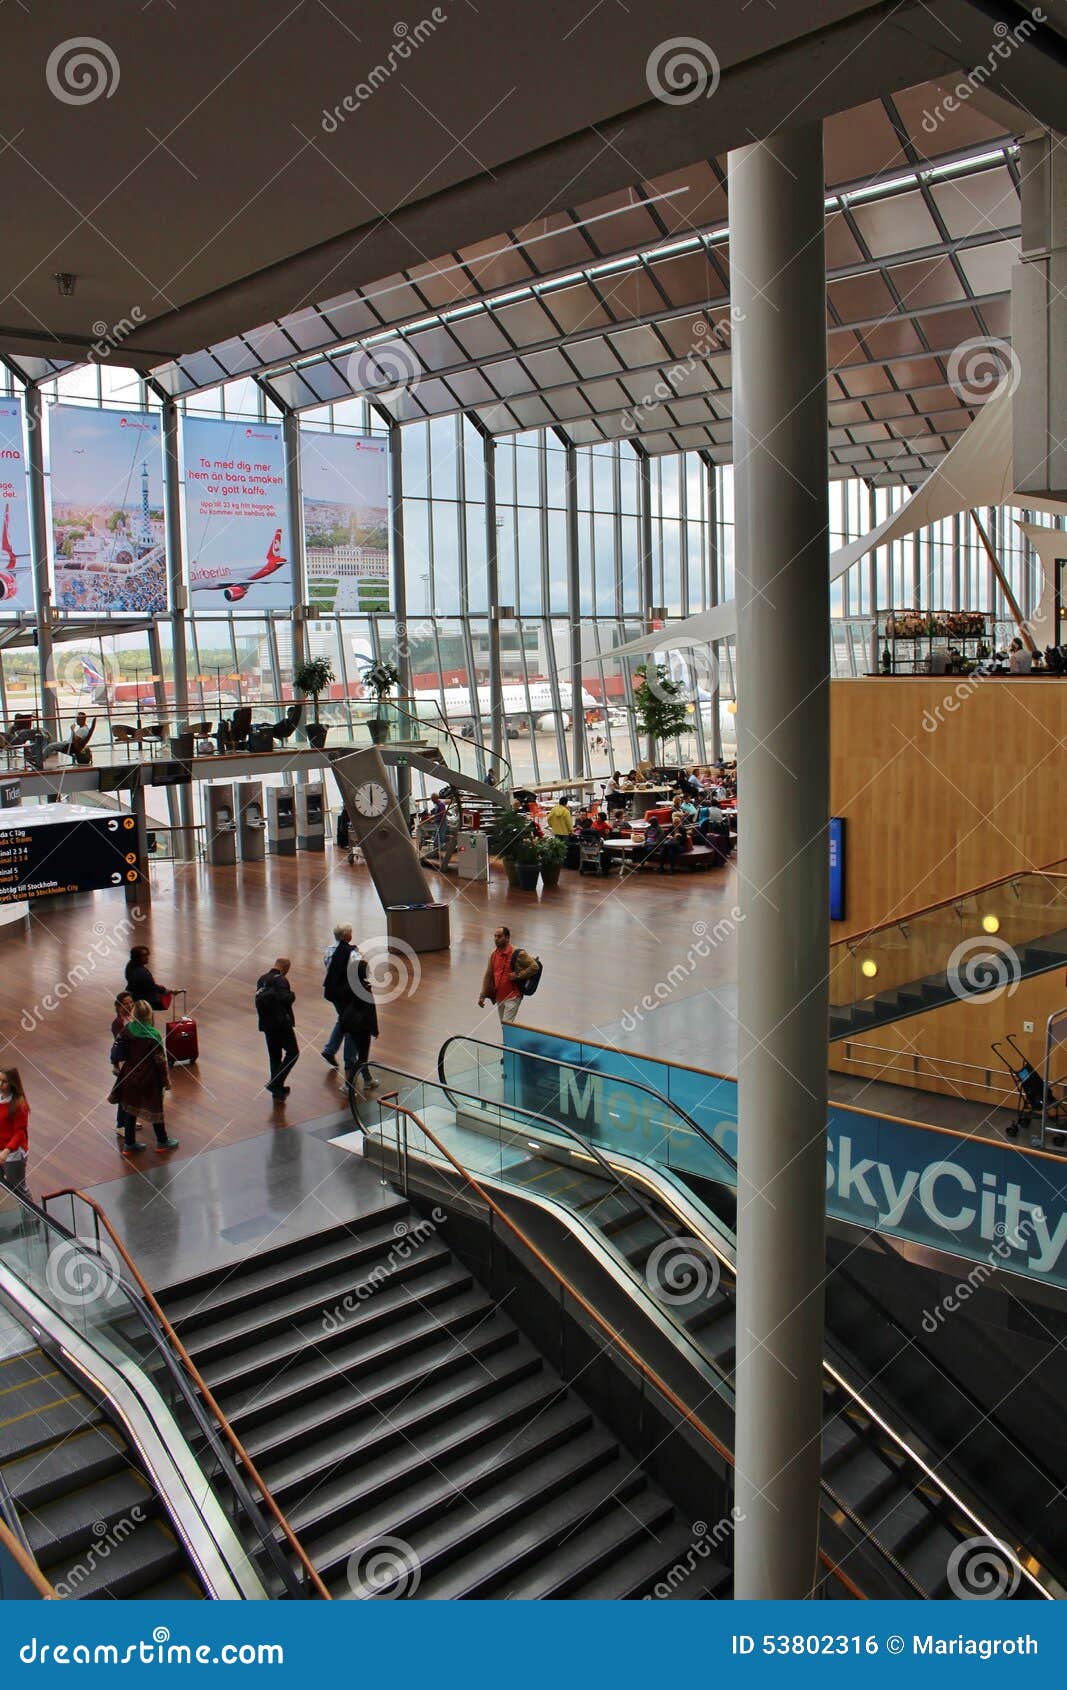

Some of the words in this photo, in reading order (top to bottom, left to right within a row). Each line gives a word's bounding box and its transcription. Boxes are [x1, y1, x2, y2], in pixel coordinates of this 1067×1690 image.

[200, 458, 211, 468] Ta
[214, 460, 234, 470] med
[237, 461, 251, 472] dig
[254, 463, 271, 472] mer
[189, 470, 209, 480] hem
[226, 472, 246, 482] bara
[249, 474, 283, 485] smaken
[207, 485, 219, 493] av
[222, 485, 240, 496] gott
[27, 880, 58, 891] Stockholm
[826, 1136, 1067, 1272] kyCity
